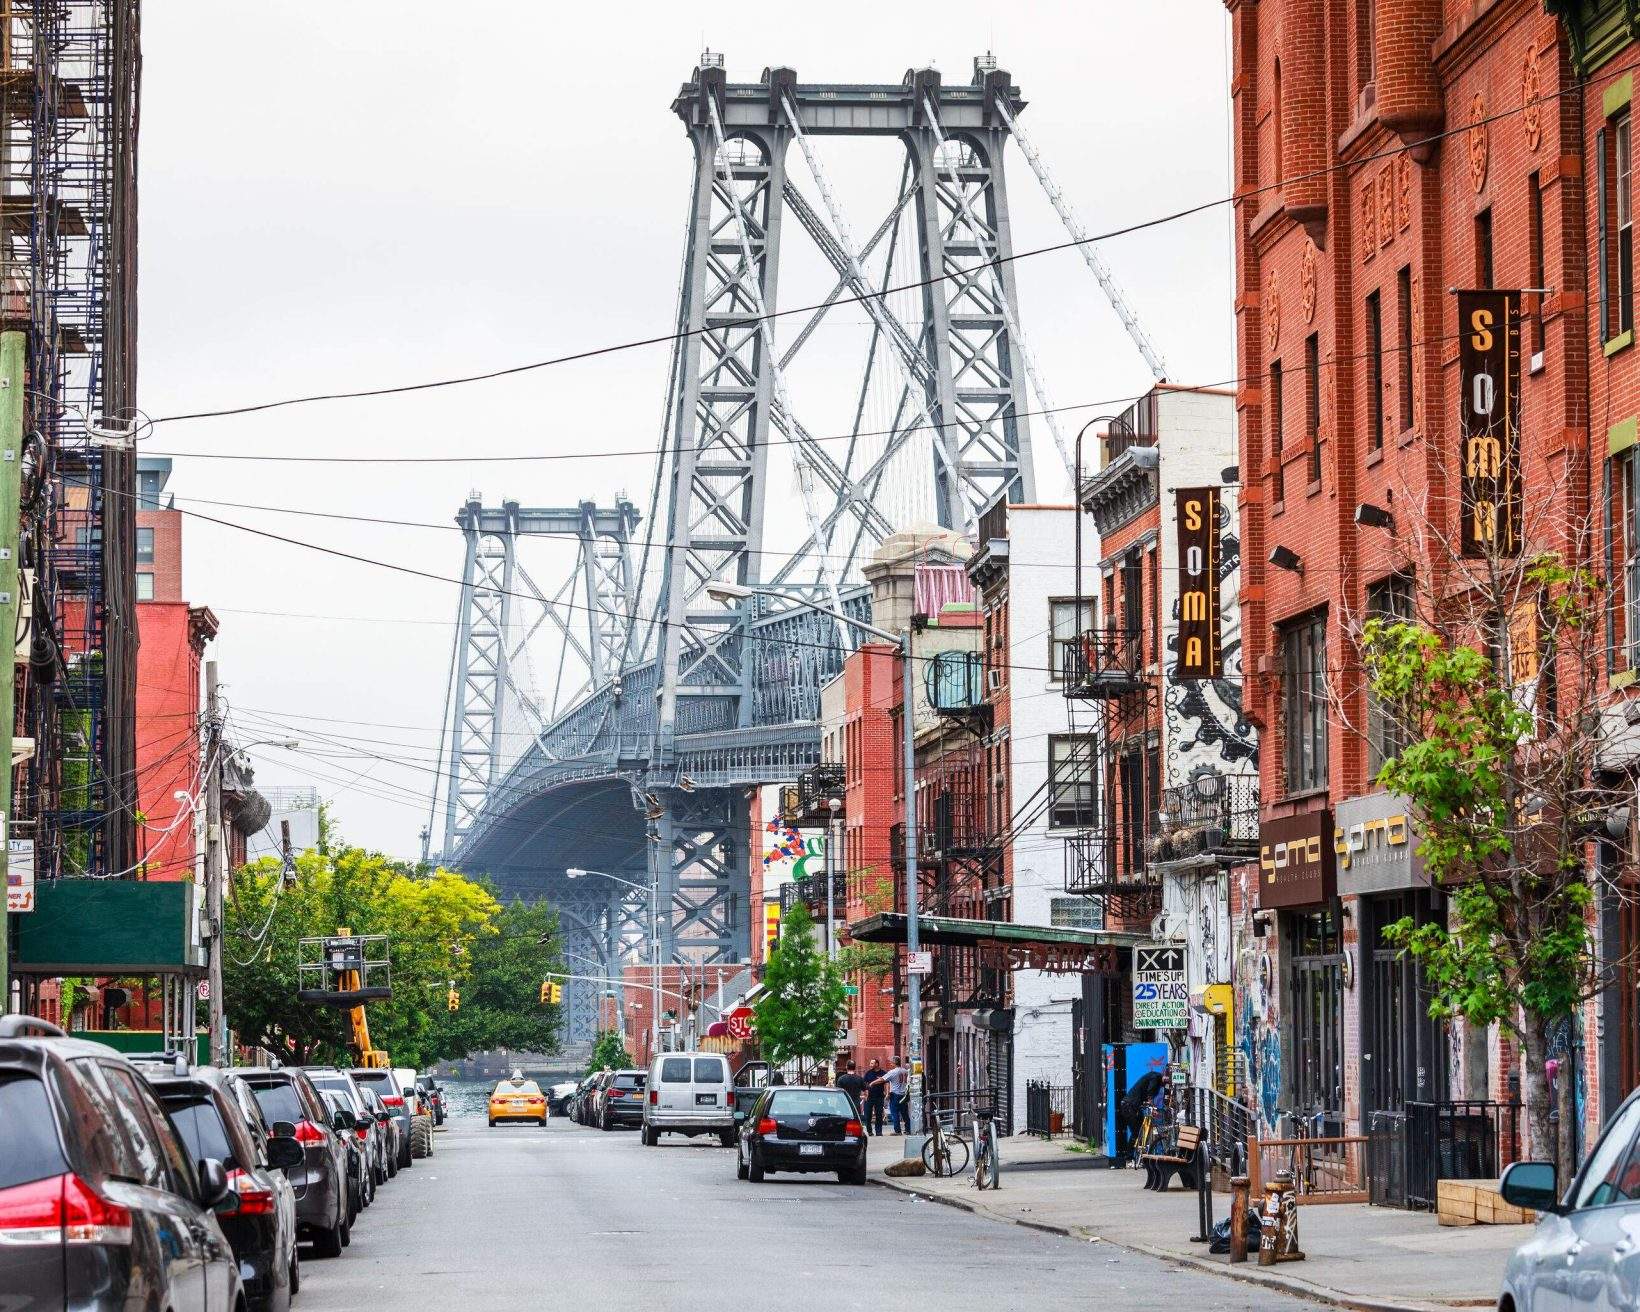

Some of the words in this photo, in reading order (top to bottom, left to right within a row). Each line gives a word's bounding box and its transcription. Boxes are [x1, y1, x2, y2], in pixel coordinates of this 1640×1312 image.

[1510, 309, 1520, 399] CLUBS
[1511, 431, 1522, 541] HEATH
[1212, 499, 1220, 564] CLUBS
[1212, 586, 1221, 666] HEALTH
[1135, 983, 1157, 1000] 25
[1155, 983, 1188, 1000] YEARS
[1137, 971, 1170, 982] TIME'S
[1135, 1002, 1159, 1010] DIRECT
[1161, 1001, 1185, 1009] ACTION
[1141, 1009, 1179, 1017] EDUCATION
